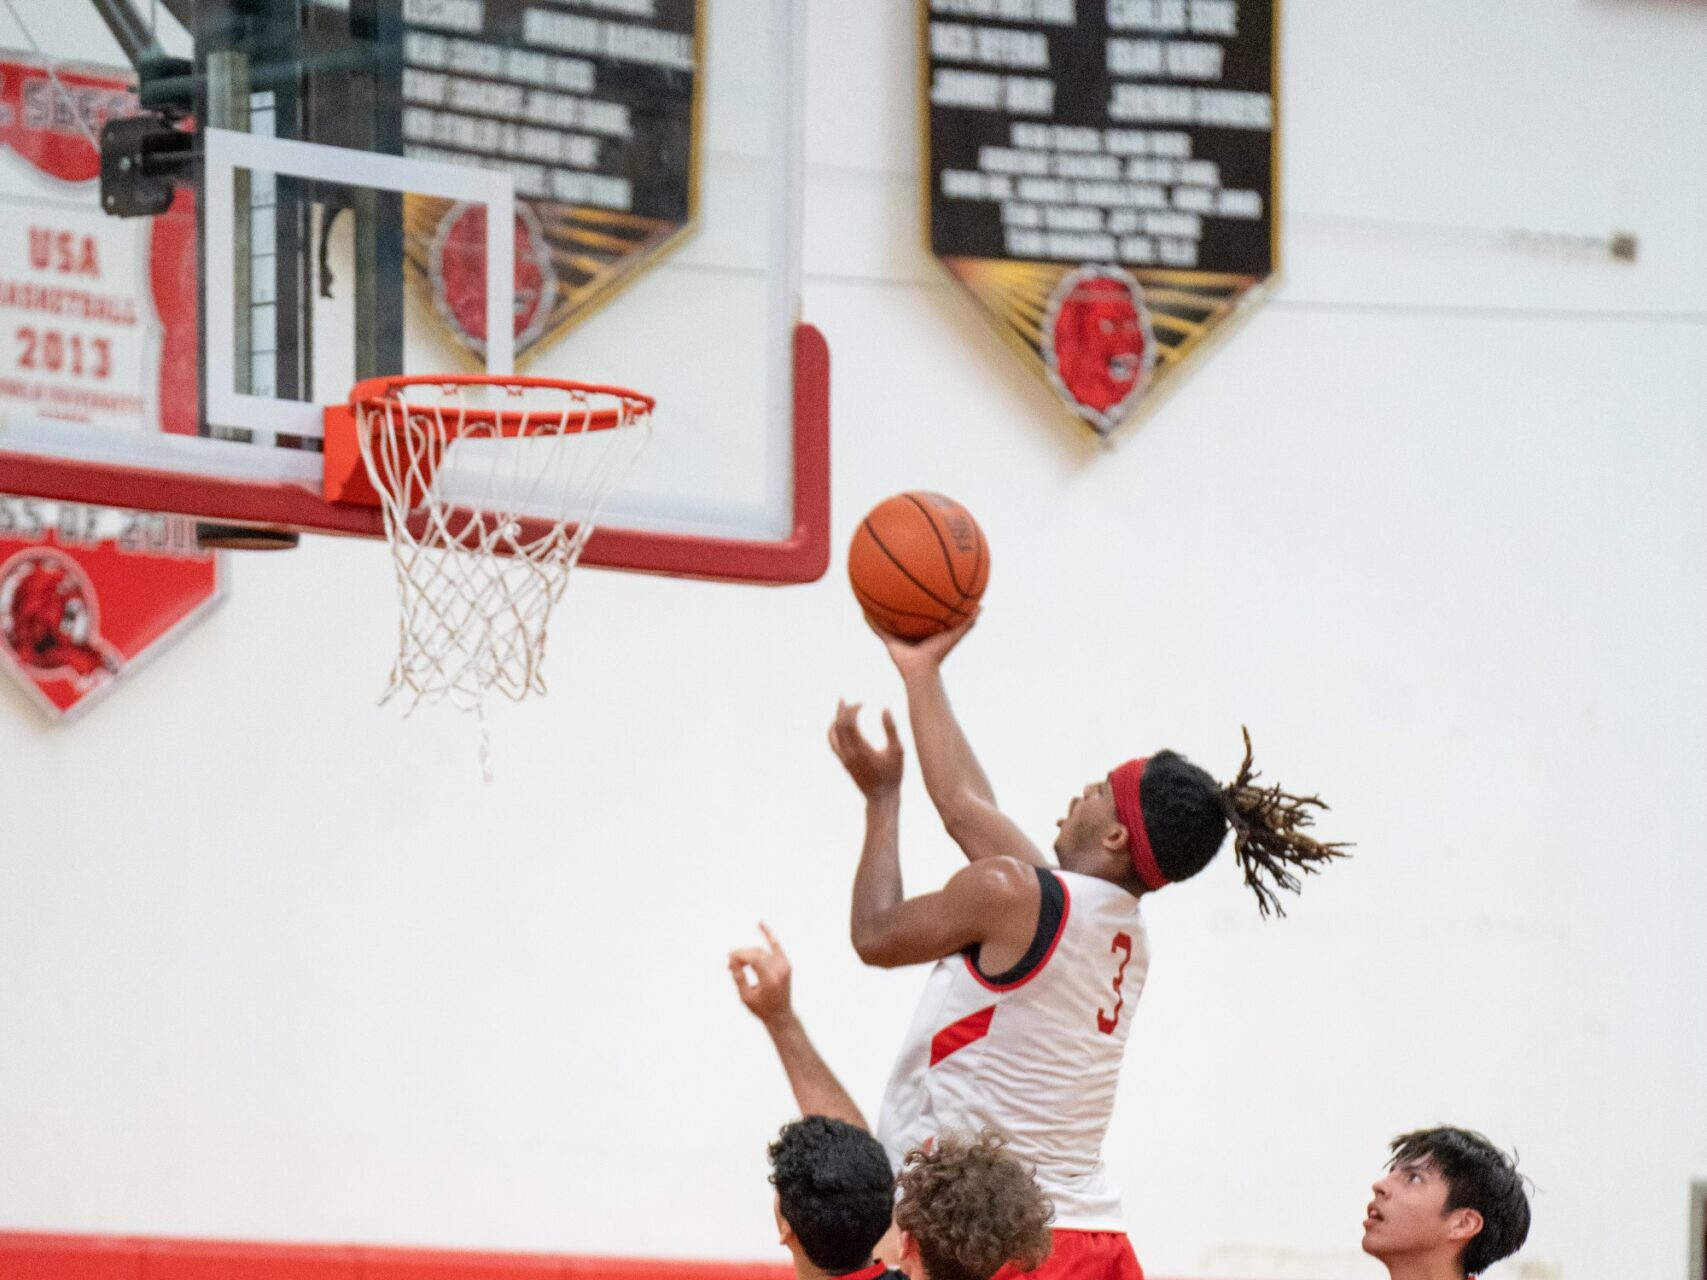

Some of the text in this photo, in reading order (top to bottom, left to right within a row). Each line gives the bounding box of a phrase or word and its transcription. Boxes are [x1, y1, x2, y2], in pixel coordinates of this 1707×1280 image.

[27, 225, 102, 281] USA
[0, 279, 138, 327] ASKETBALL
[16, 325, 113, 380] 2013
[1097, 931, 1131, 1035] 3
